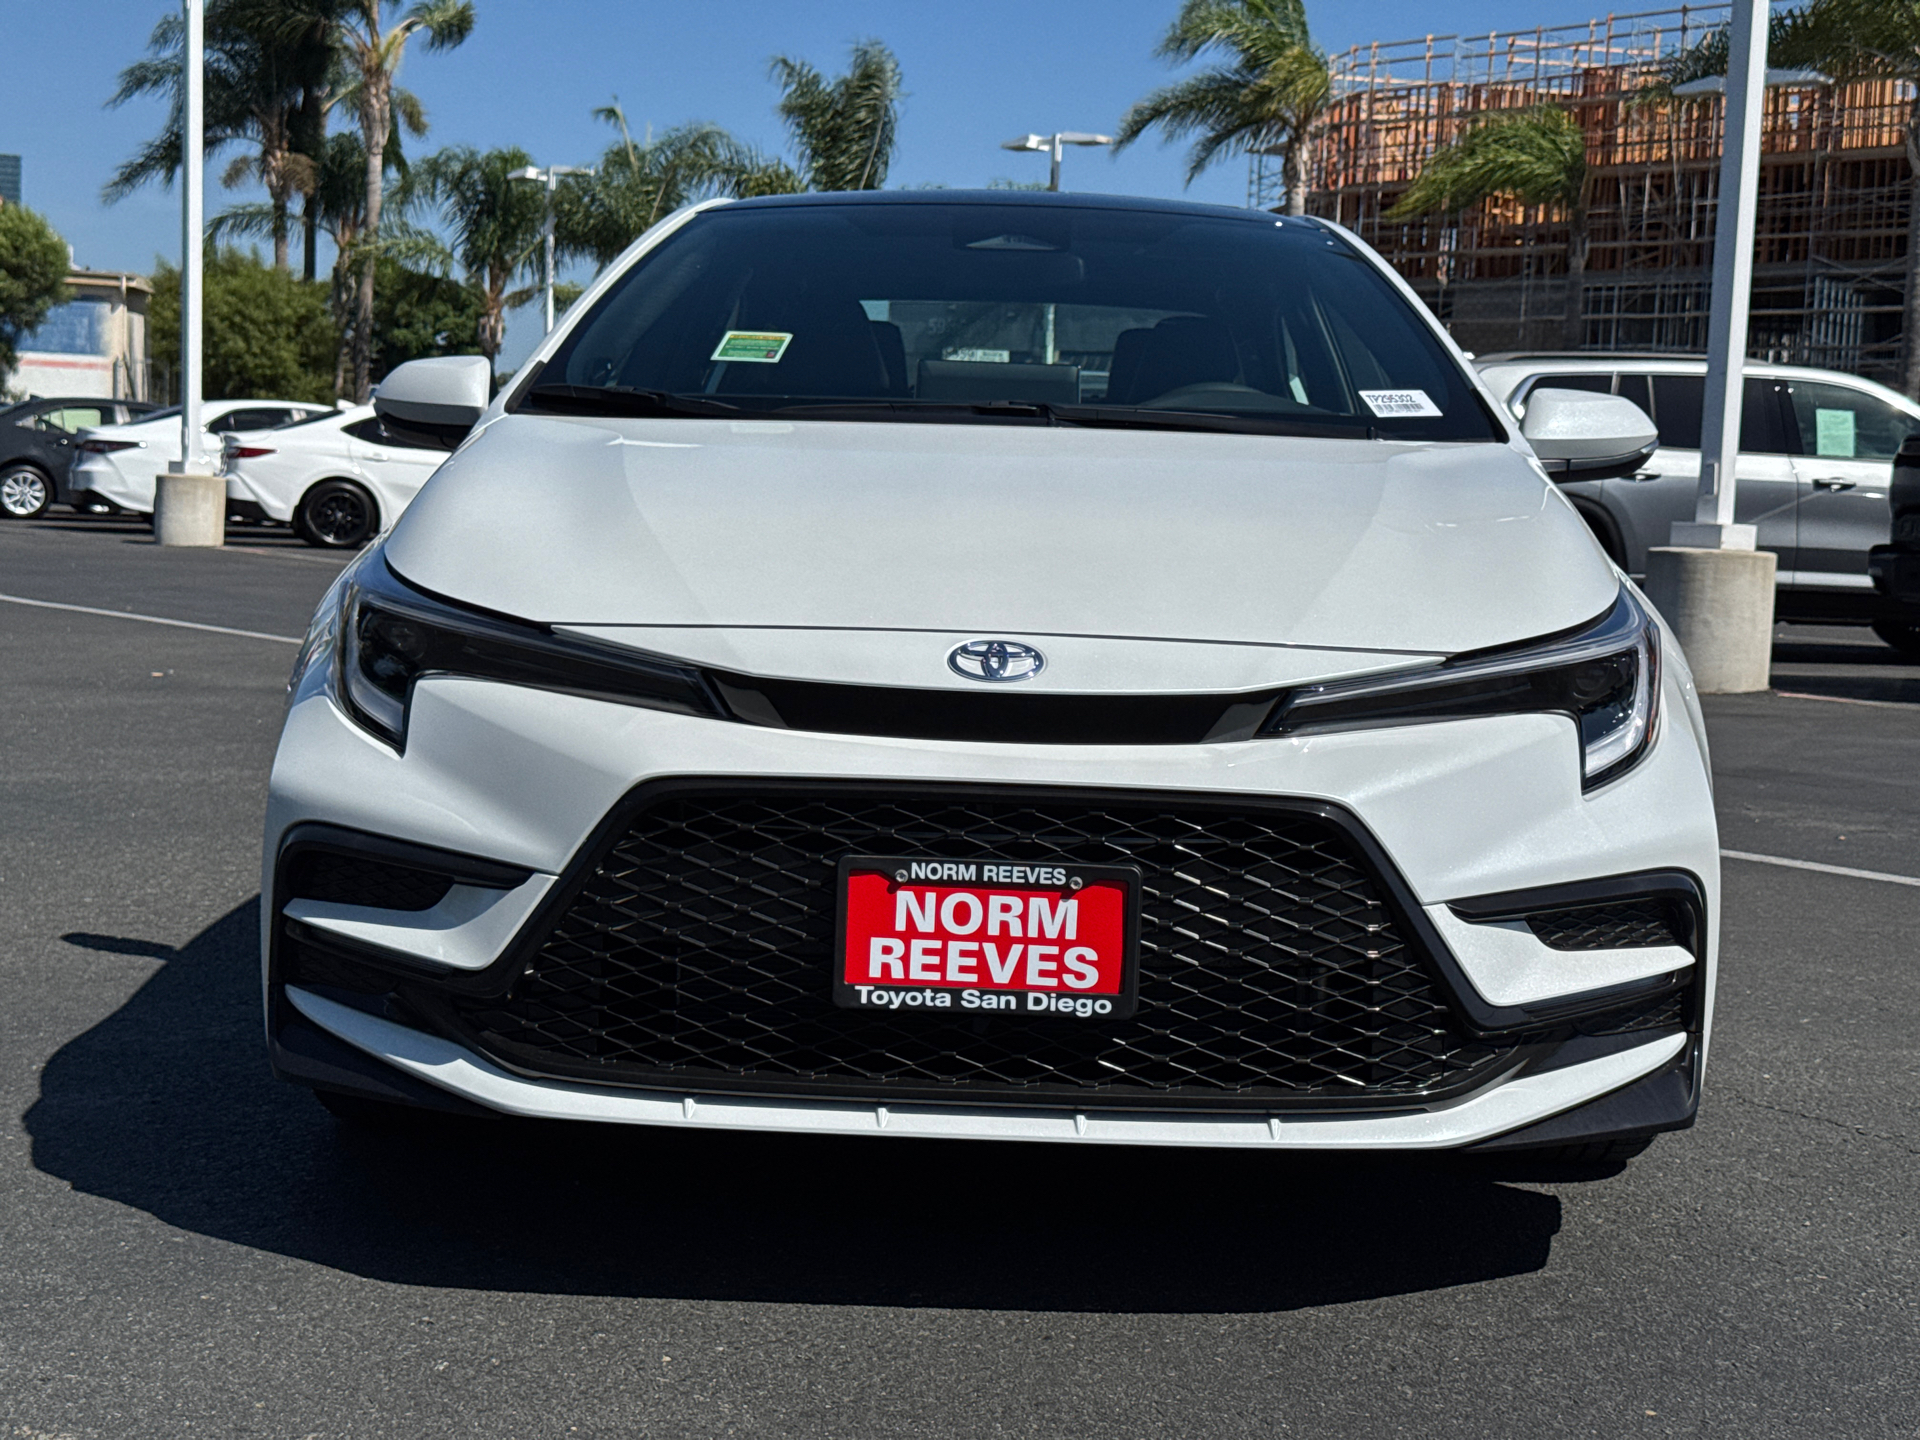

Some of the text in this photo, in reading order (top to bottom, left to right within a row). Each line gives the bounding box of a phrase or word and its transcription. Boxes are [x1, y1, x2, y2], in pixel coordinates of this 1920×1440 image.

[911, 862, 1067, 886] NORM REEVES
[894, 890, 1079, 940] NORM
[868, 936, 1100, 989] REEVES
[854, 985, 1113, 1018] Toyota San Diego
